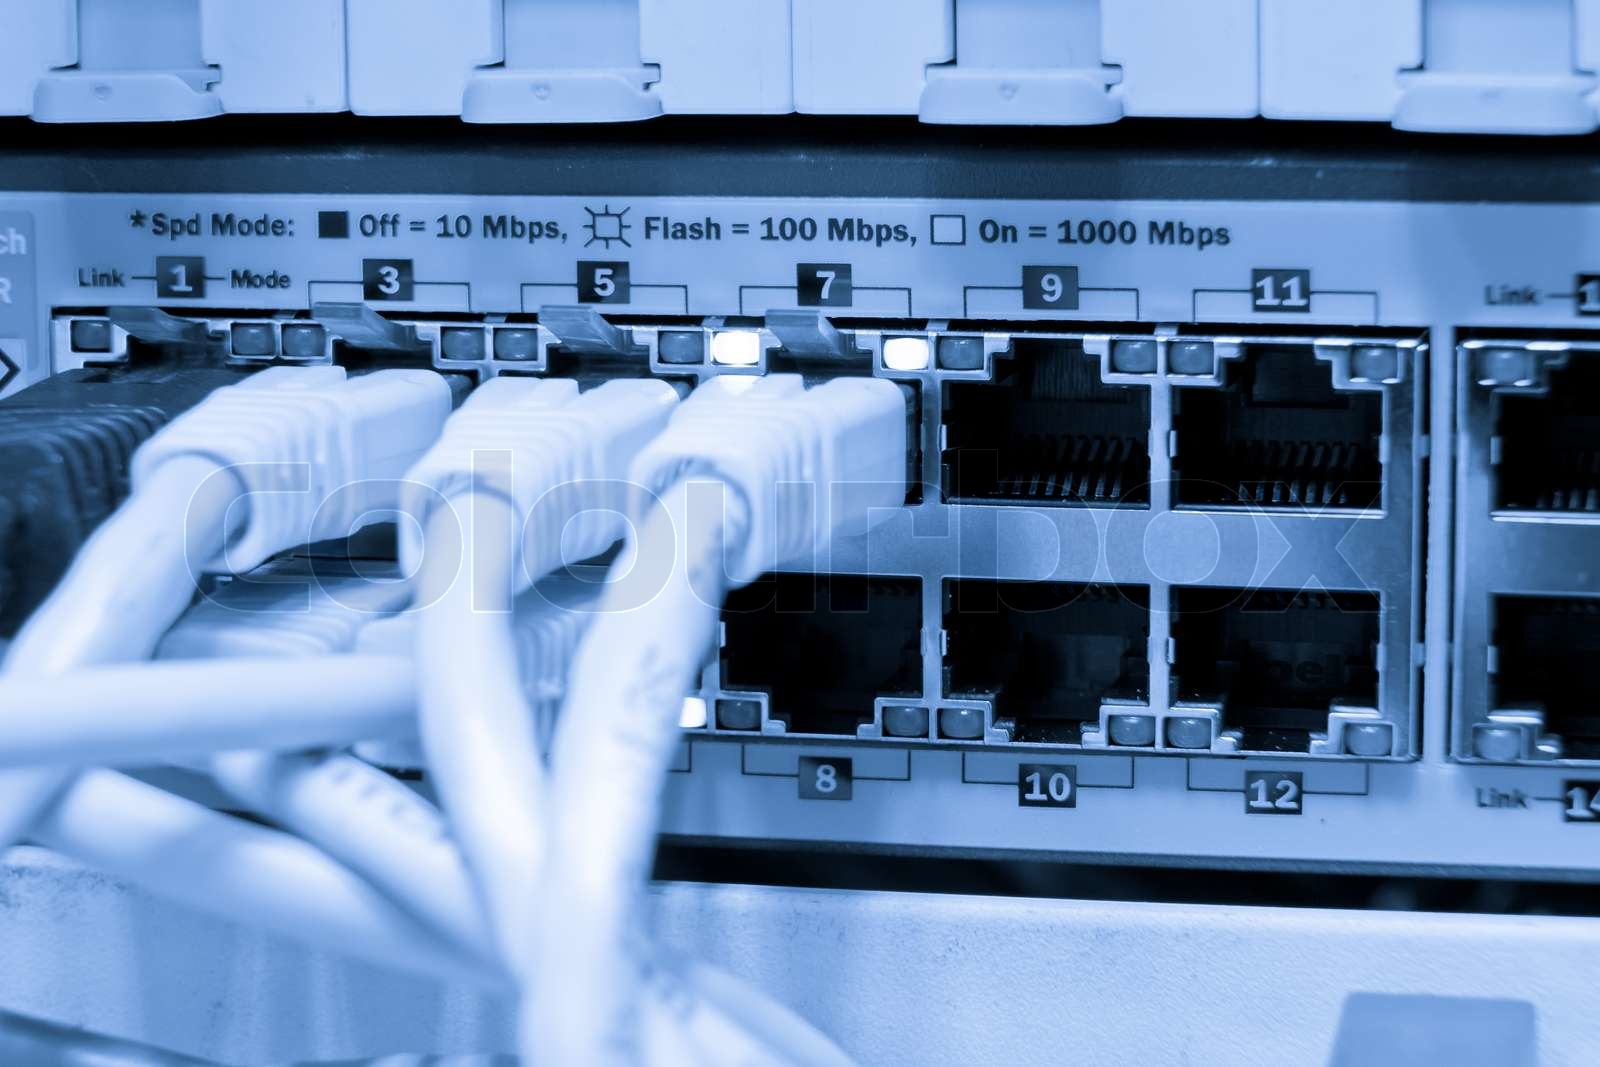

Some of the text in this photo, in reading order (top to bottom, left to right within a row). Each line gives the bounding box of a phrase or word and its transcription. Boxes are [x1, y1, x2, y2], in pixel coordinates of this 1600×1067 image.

[211, 213, 294, 237] Mode:
[359, 213, 400, 238] Off
[436, 214, 472, 238] 10
[482, 215, 568, 244] Mbps,
[644, 216, 721, 240] Flash
[760, 216, 818, 241] 100
[827, 217, 917, 247] Mbps,
[978, 219, 1018, 244] On
[1057, 219, 1137, 245] 1000
[1148, 220, 1231, 250] Mbps
[78, 264, 291, 292] Link 1 Mode
[377, 266, 400, 294] 3
[593, 268, 616, 297] 5
[816, 270, 836, 299] 7
[1040, 273, 1064, 302] 9
[1254, 275, 1309, 306] 11
[814, 763, 838, 793] 8
[1023, 771, 1071, 802] 10
[1249, 778, 1299, 809] 12
